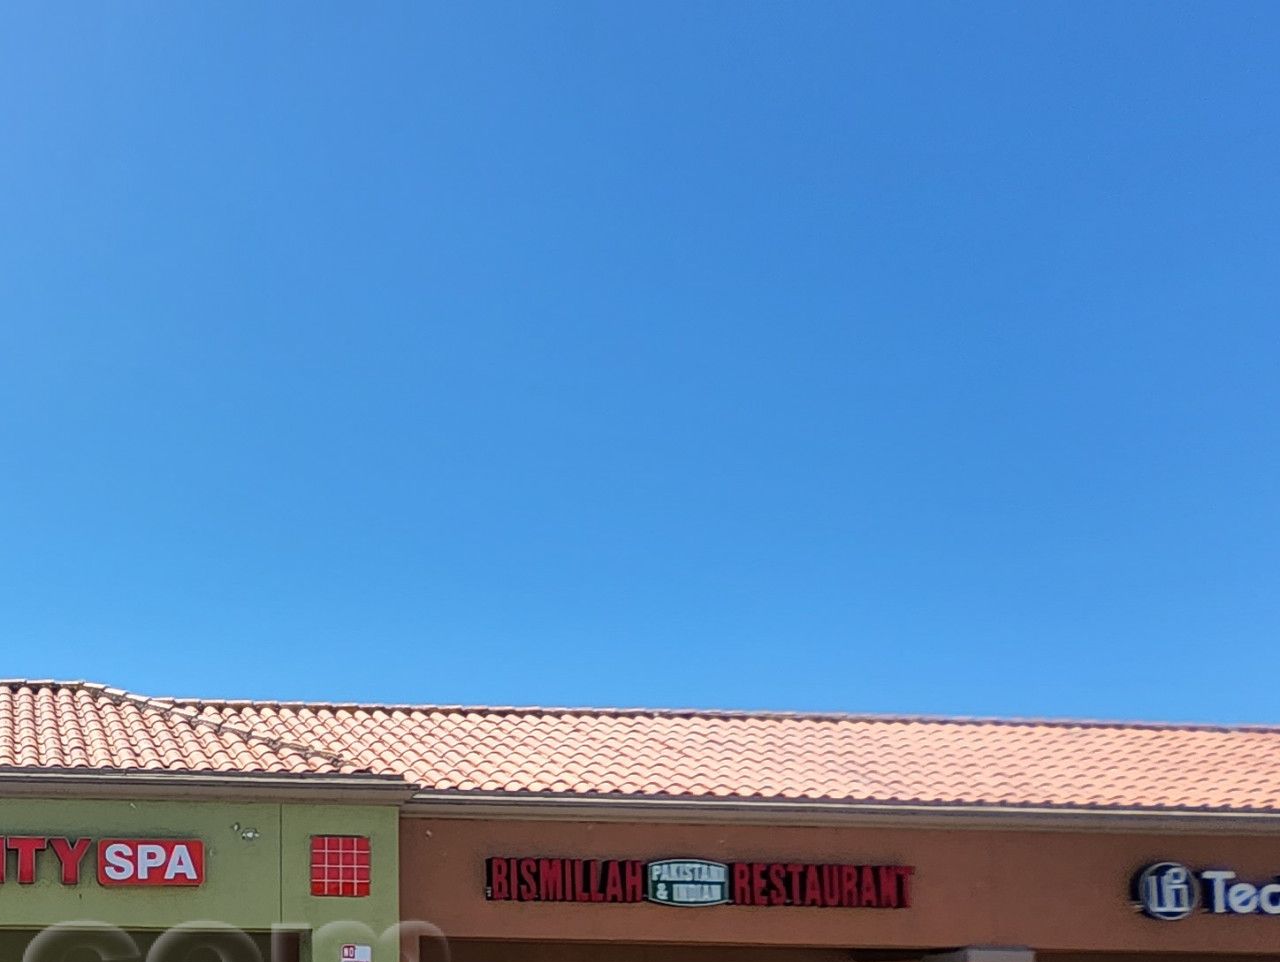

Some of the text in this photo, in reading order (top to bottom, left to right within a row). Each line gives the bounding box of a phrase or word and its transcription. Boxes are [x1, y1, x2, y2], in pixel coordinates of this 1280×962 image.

[104, 843, 198, 881] SPA
[487, 857, 915, 908] BISMILLAH RESTAURANT
